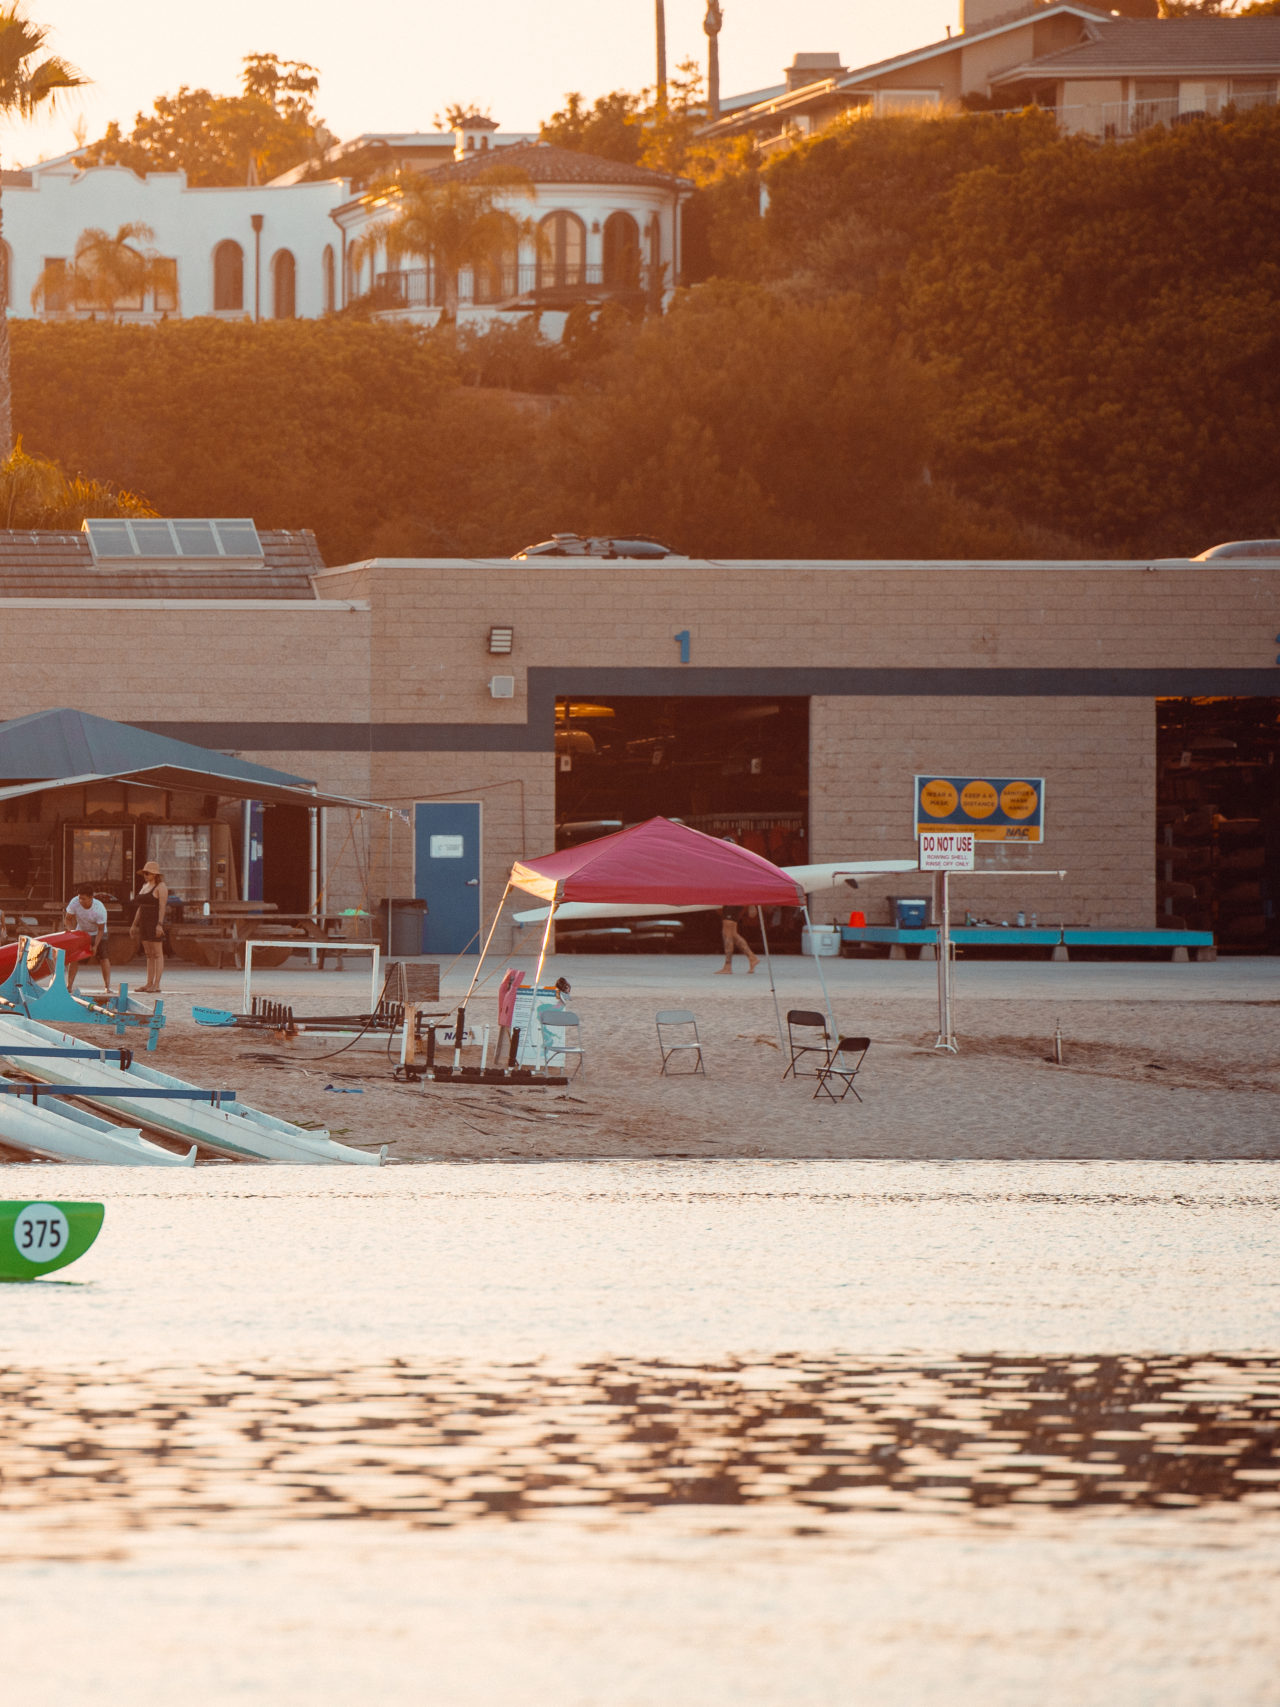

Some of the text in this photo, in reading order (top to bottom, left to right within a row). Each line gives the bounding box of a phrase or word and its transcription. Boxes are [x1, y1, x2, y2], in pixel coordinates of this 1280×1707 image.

[674, 630, 690, 663] 1
[1006, 828, 1030, 837] NAC
[923, 836, 972, 852] DO NOT USE
[444, 1031, 468, 1041] NC
[22, 1220, 61, 1249] 375
